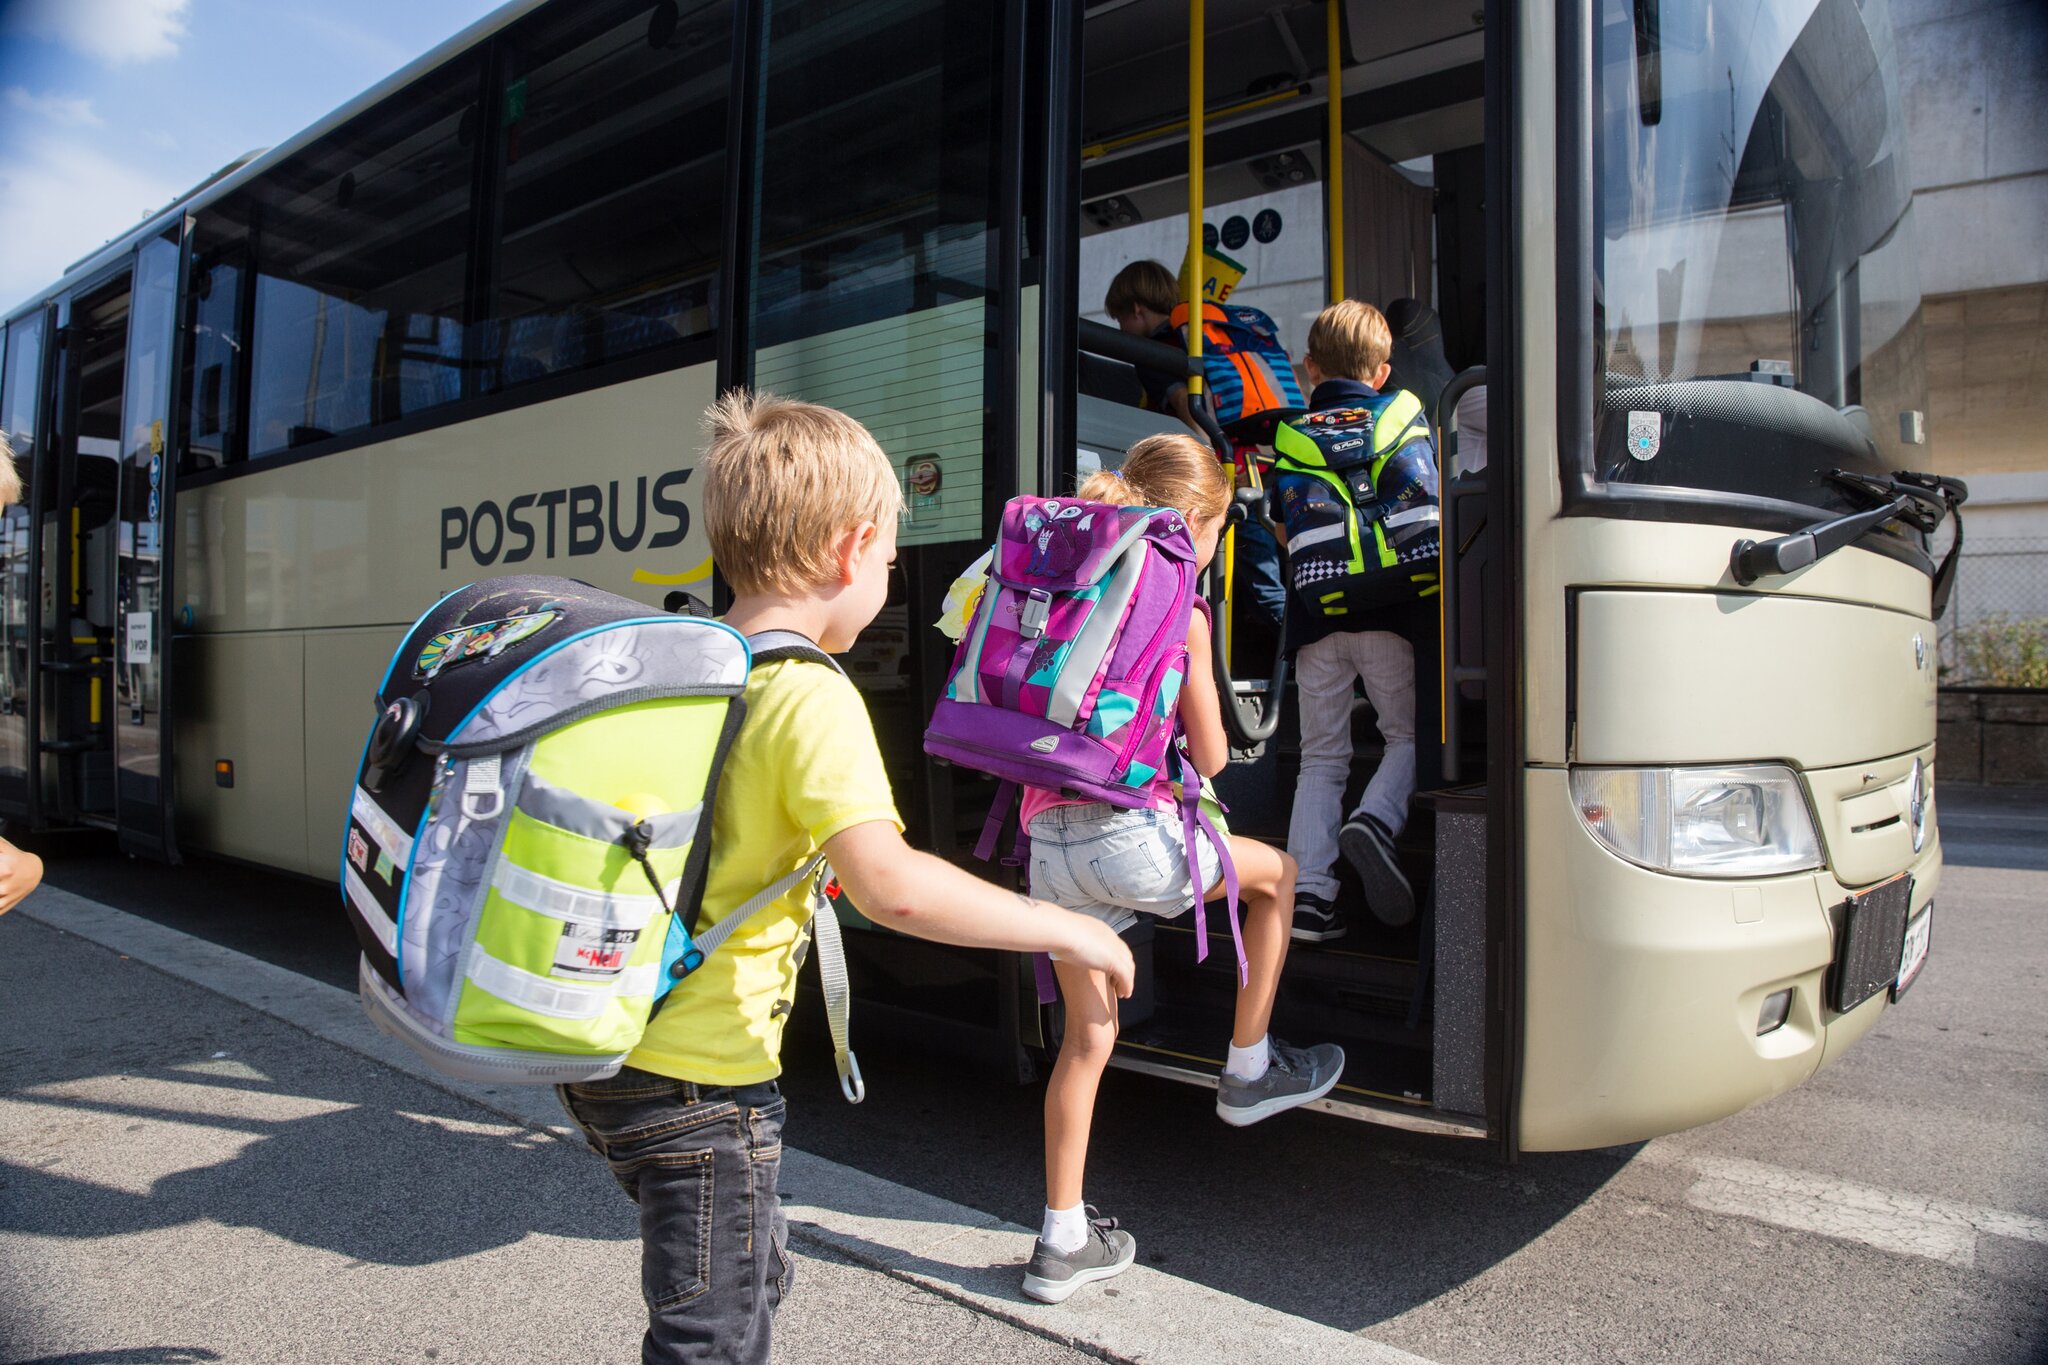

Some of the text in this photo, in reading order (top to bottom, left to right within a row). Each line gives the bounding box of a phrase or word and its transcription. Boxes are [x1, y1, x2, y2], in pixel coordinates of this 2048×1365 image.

[1218, 284, 1232, 302] E
[440, 467, 694, 570] POSTBUS
[614, 931, 635, 943] 912
[575, 946, 624, 968] McNeill
